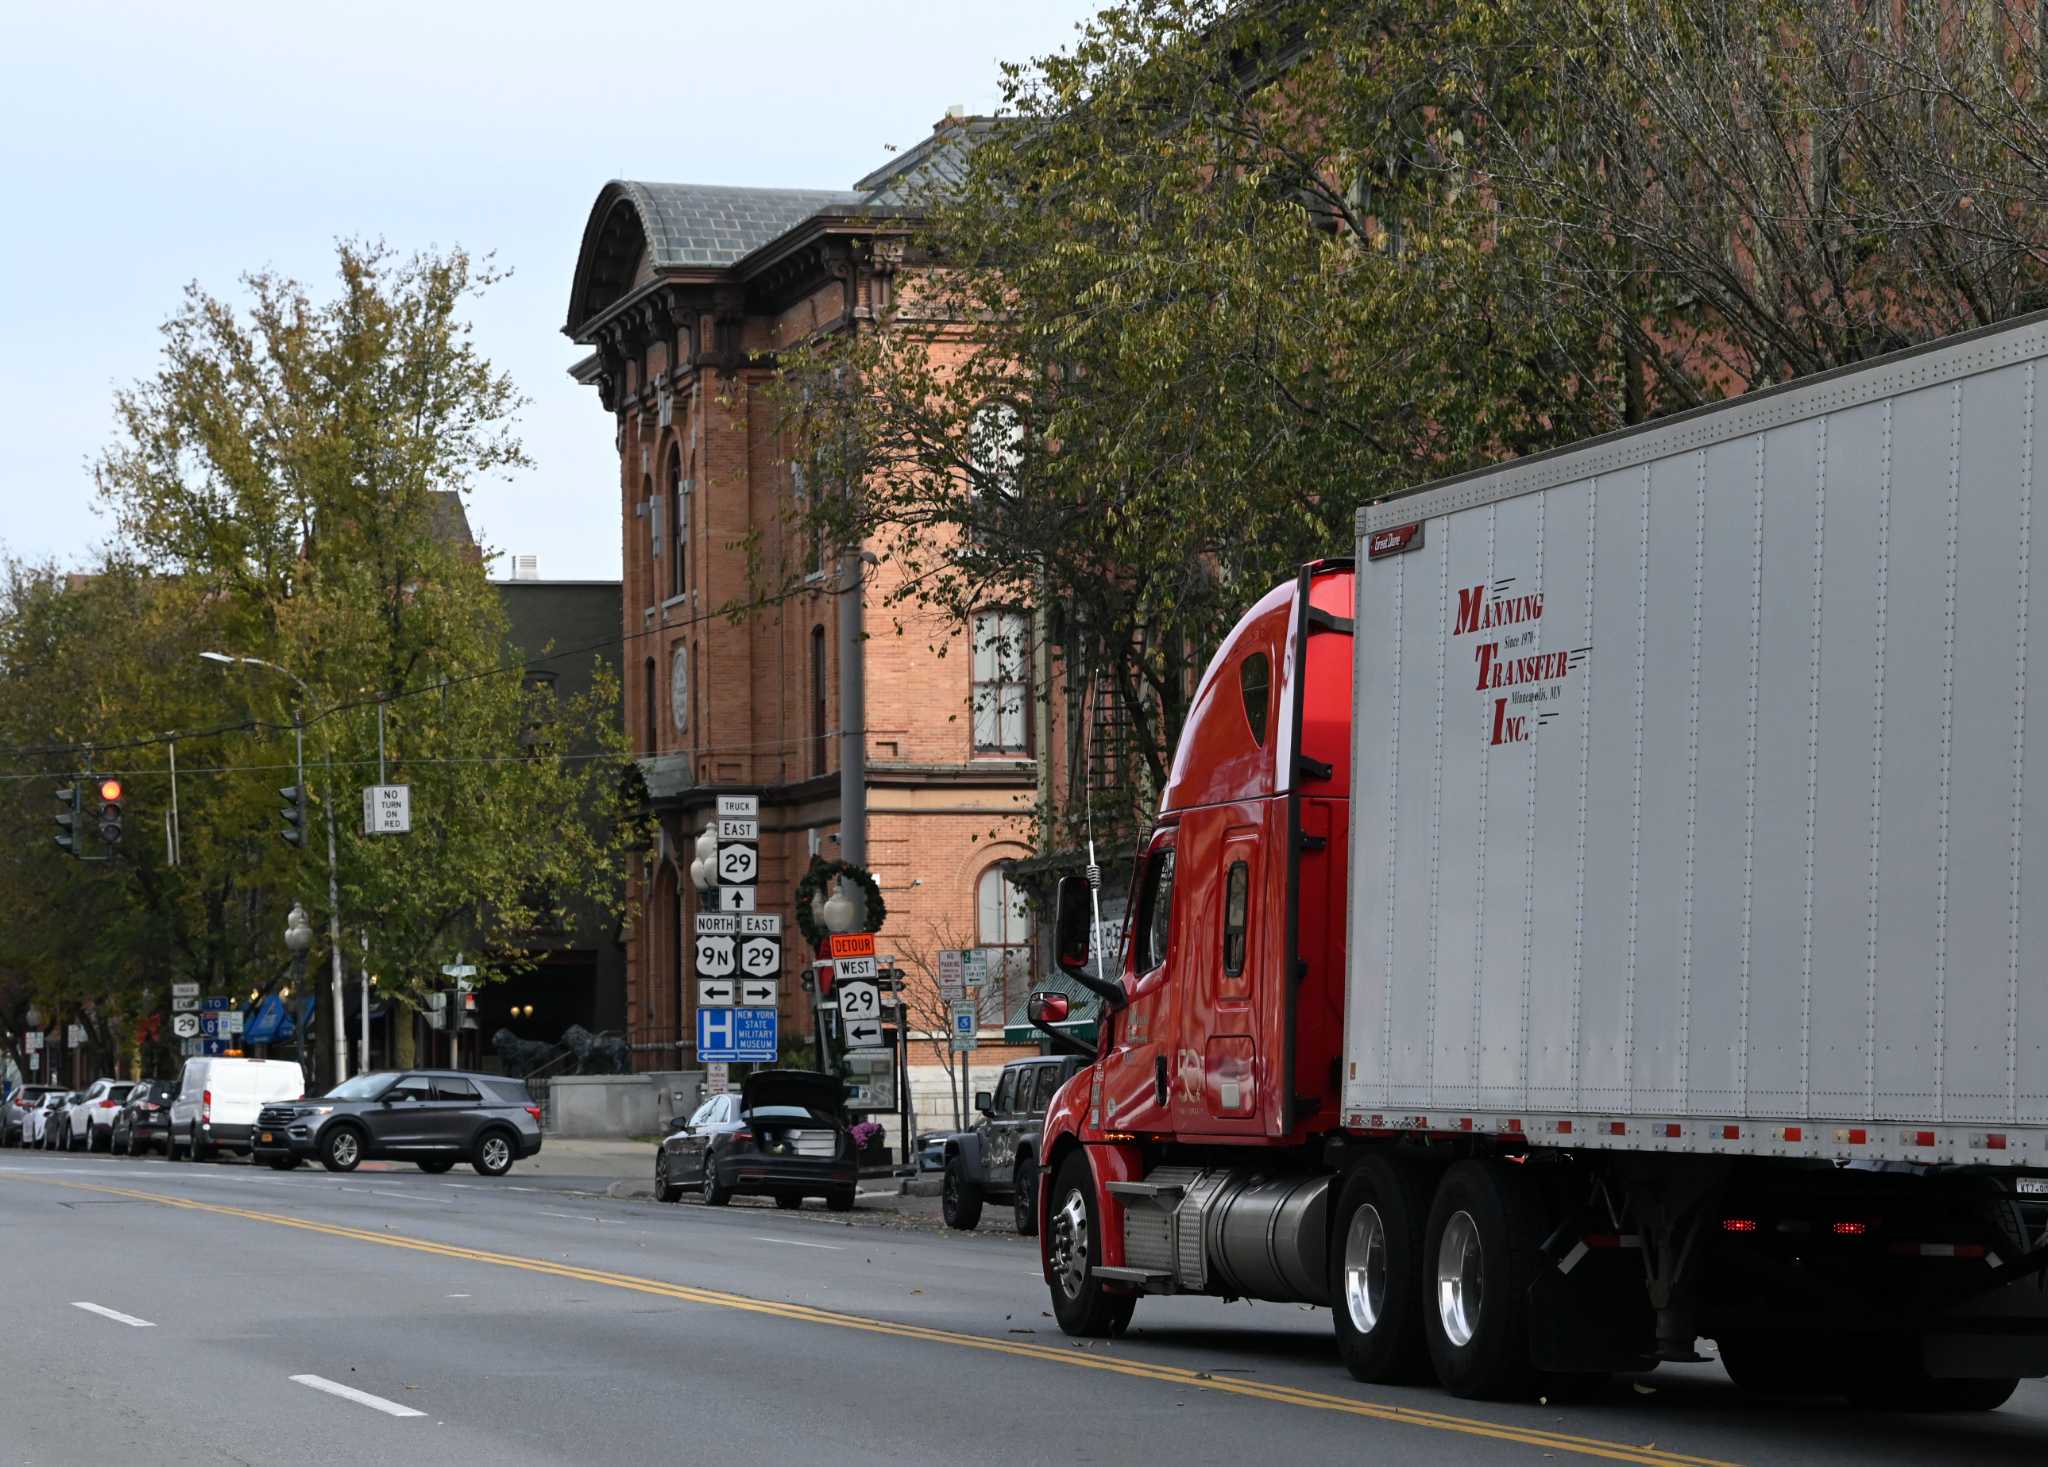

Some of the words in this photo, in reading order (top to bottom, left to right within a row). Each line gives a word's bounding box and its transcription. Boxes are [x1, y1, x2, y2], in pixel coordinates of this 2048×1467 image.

[1453, 585, 1544, 636] MANNING
[1504, 635, 1519, 649] Since
[1475, 642, 1568, 691] TRANSFER
[1490, 698, 1529, 745] INC.
[384, 790, 398, 799] NO
[382, 801, 402, 809] TURN
[725, 802, 750, 811] TRUCK
[386, 810, 397, 818] ON
[384, 820, 400, 828] RED
[724, 823, 751, 836] EAST
[725, 853, 751, 873] 29
[698, 918, 733, 930] NORTH
[746, 918, 774, 931] EAST
[835, 939, 871, 952] DETOUR
[703, 947, 728, 966] 9N
[748, 948, 774, 966] 29
[841, 960, 870, 974] WEST
[208, 1000, 221, 1008] TO
[844, 991, 873, 1012] 29
[738, 1010, 752, 1019] NEW
[756, 1010, 774, 1019] YORK
[178, 1019, 195, 1032] 29
[703, 1010, 732, 1048] H
[745, 1020, 767, 1029] STATE
[738, 1030, 773, 1039] MILITARY
[740, 1039, 772, 1049] MUSEUM
